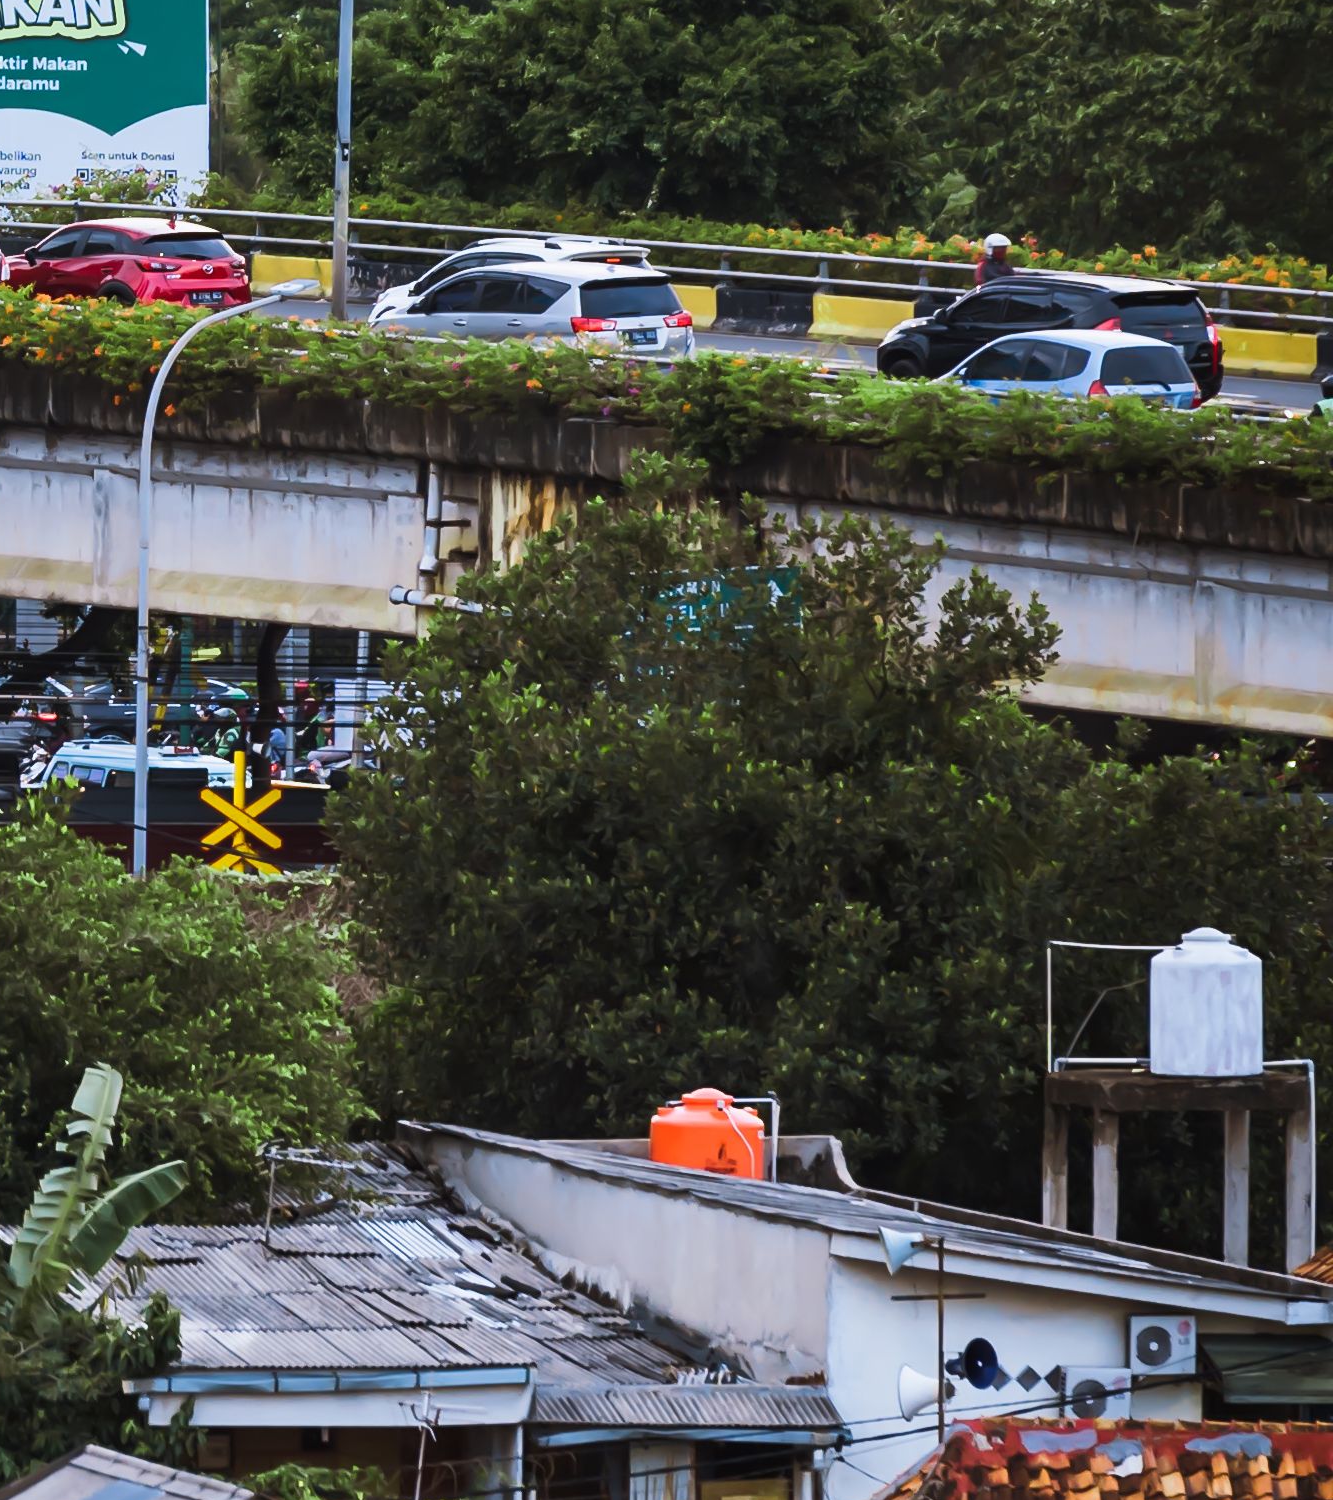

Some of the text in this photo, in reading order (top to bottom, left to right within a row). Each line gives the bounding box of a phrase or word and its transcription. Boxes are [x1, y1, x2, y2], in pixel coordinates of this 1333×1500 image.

[32, 56, 87, 71] Makan
[108, 151, 138, 160] untuk
[141, 152, 176, 161] Donasi
